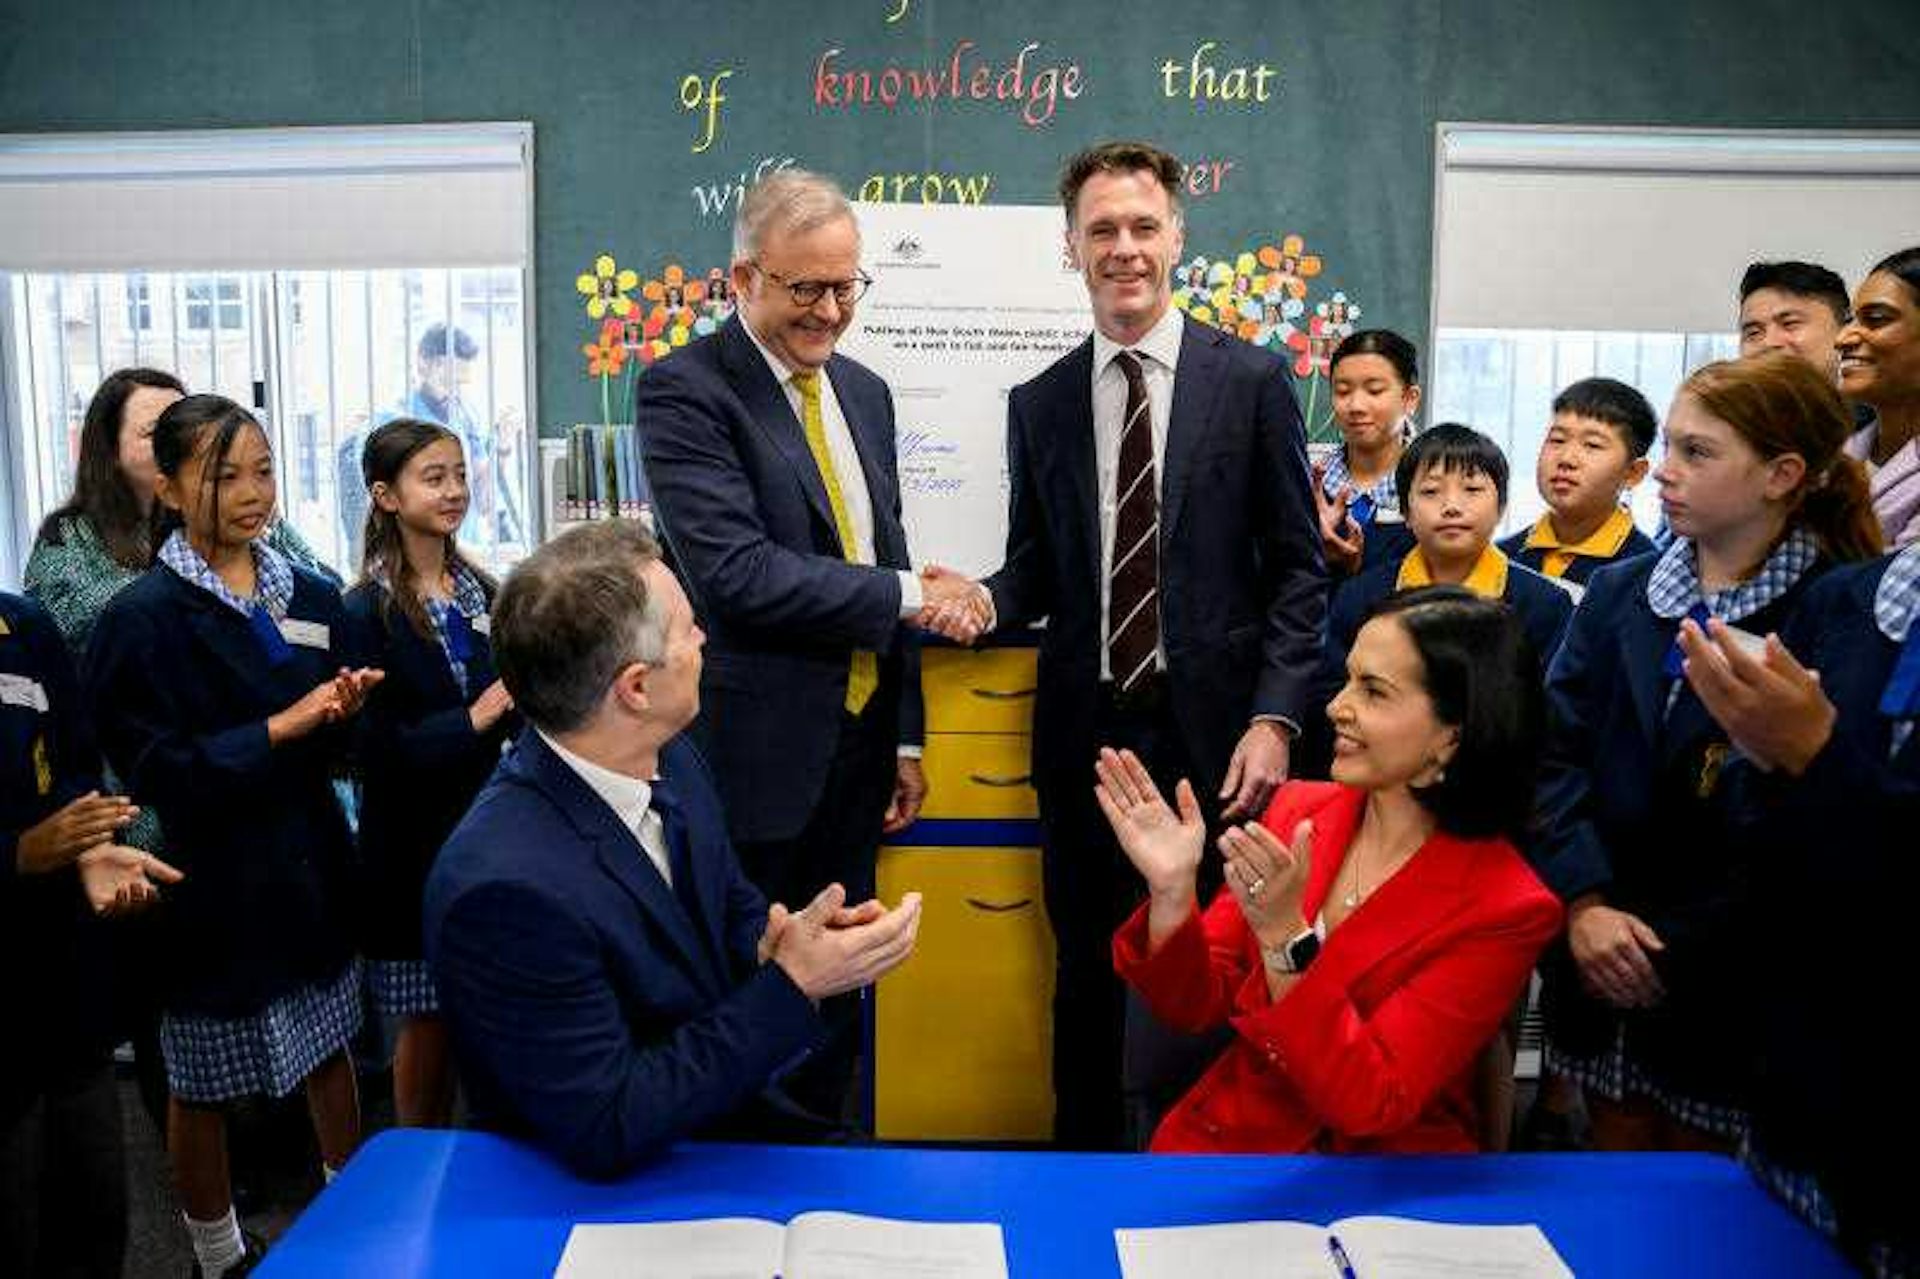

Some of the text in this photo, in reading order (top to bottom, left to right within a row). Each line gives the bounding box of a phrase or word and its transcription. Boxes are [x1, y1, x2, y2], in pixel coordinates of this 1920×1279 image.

[682, 41, 1277, 152] of knowledge that
